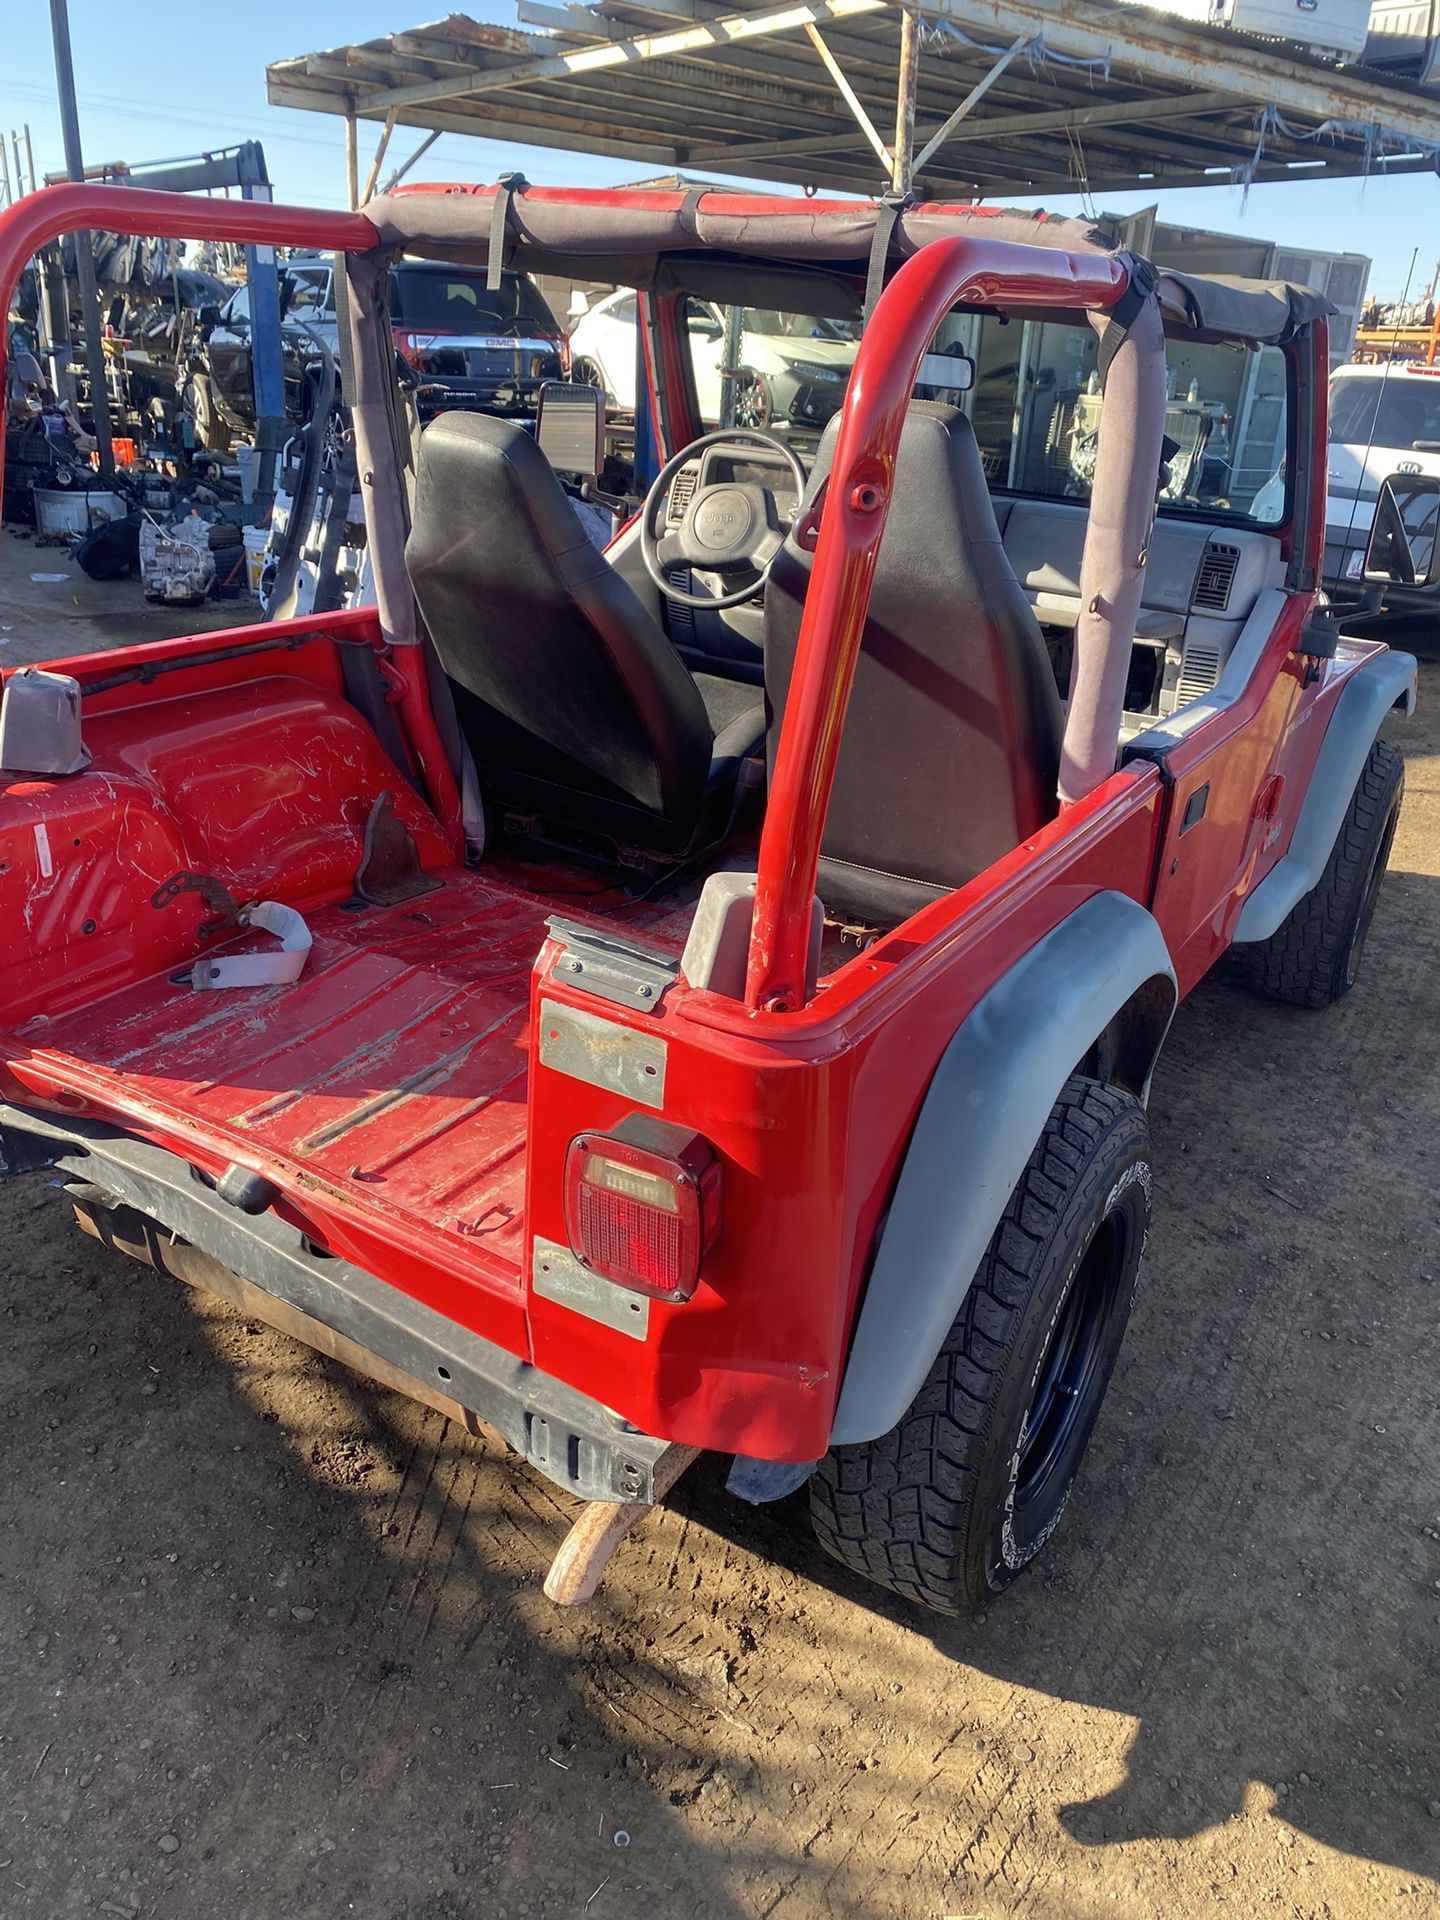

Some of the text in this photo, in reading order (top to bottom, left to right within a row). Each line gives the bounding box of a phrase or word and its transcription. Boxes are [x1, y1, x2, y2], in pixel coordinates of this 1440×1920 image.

[486, 338, 515, 346] GMC
[1399, 462, 1419, 474] KIA
[706, 512, 735, 525] Jeep
